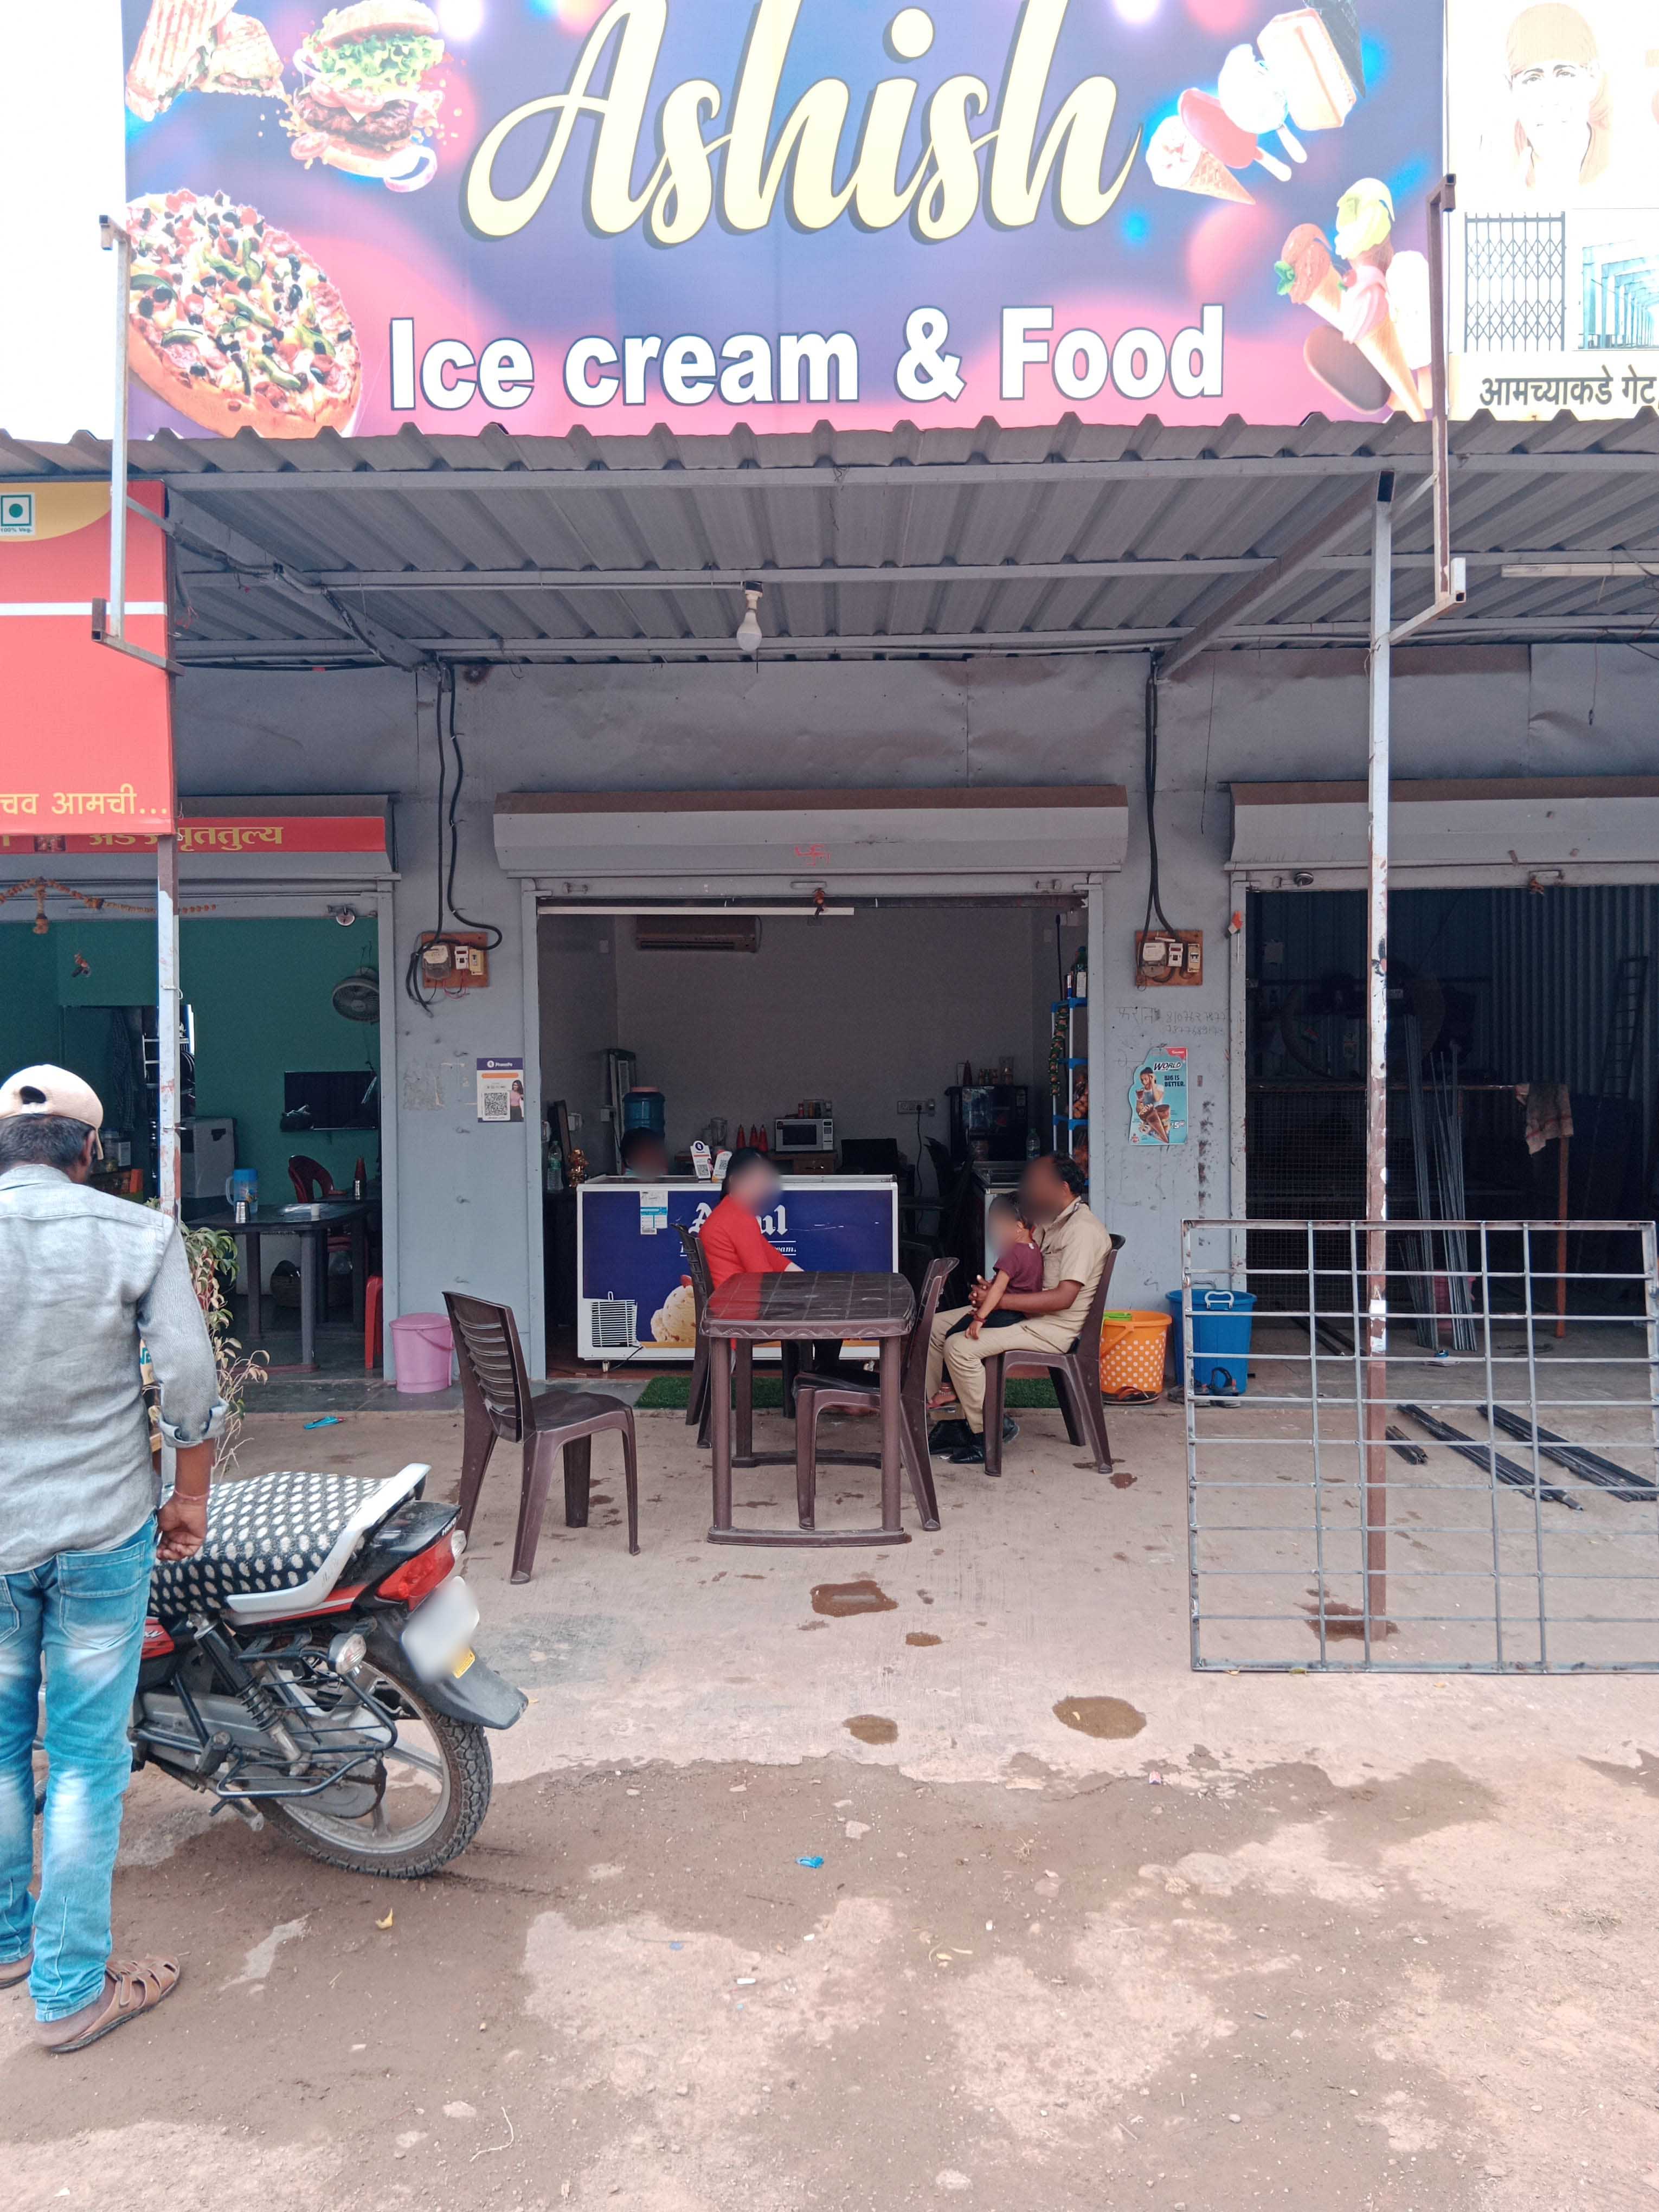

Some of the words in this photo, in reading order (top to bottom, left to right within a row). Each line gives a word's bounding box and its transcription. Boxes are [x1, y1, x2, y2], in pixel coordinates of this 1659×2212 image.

[466, 0, 1142, 243] Ashish
[390, 318, 535, 410] Ice
[564, 325, 860, 407] cream
[895, 306, 968, 403] &
[999, 304, 1226, 401] Food
[1480, 364, 1614, 406] आमच्याकडे
[688, 1202, 788, 1236] Aul
